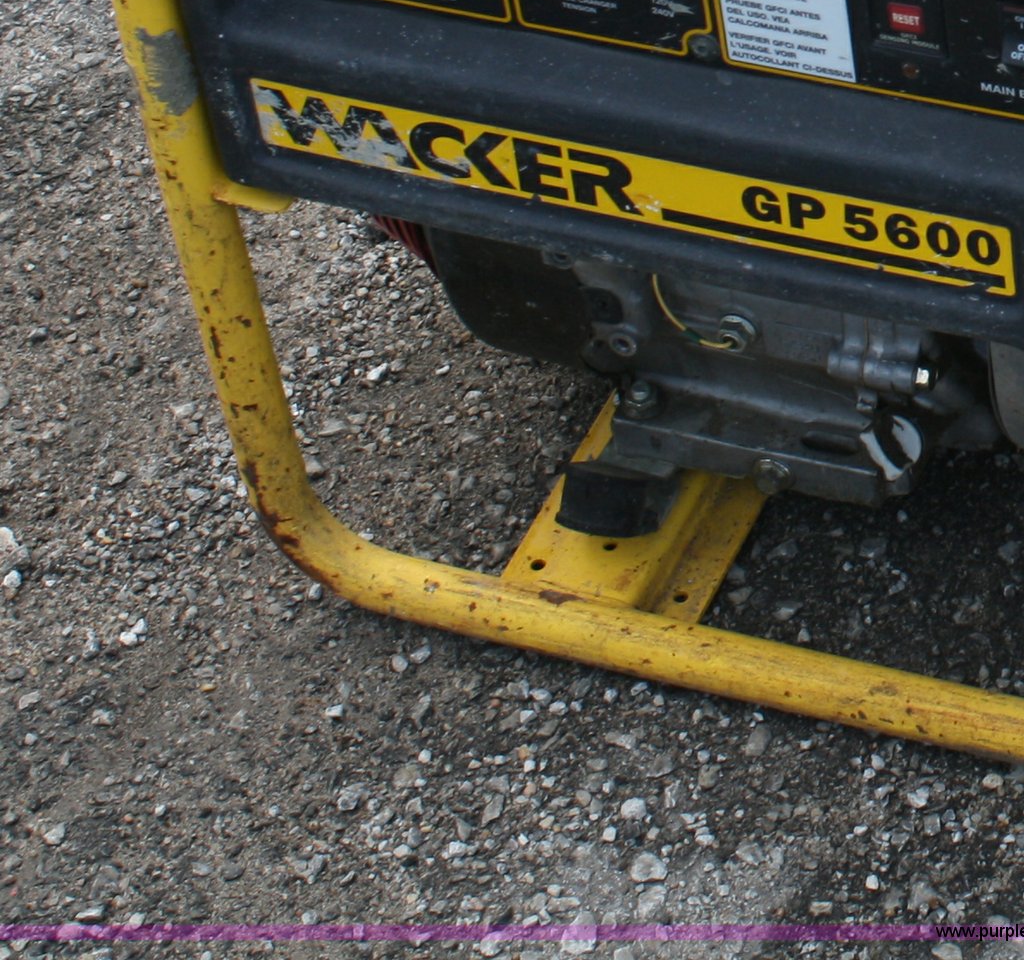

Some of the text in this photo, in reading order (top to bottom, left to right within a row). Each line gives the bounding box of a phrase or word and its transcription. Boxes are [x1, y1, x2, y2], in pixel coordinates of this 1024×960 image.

[562, 2, 597, 14] TENSION
[652, 7, 675, 18] 240V
[727, 7, 744, 16] DEL
[772, 15, 790, 24] VEA
[766, 4, 787, 14] GFCI
[790, 10, 821, 20] ANTES
[892, 12, 919, 26] RESET
[728, 17, 828, 40] CALCOMANIA ARRIBA
[773, 40, 794, 50] GFCI
[797, 44, 826, 55] AVANT
[775, 50, 797, 58] VOIR
[732, 51, 853, 79] AUTOCOLLANT CI-DESSUS
[980, 82, 1015, 96] MAIN
[256, 87, 644, 216] WACKER
[741, 186, 1001, 266] GP 5600
